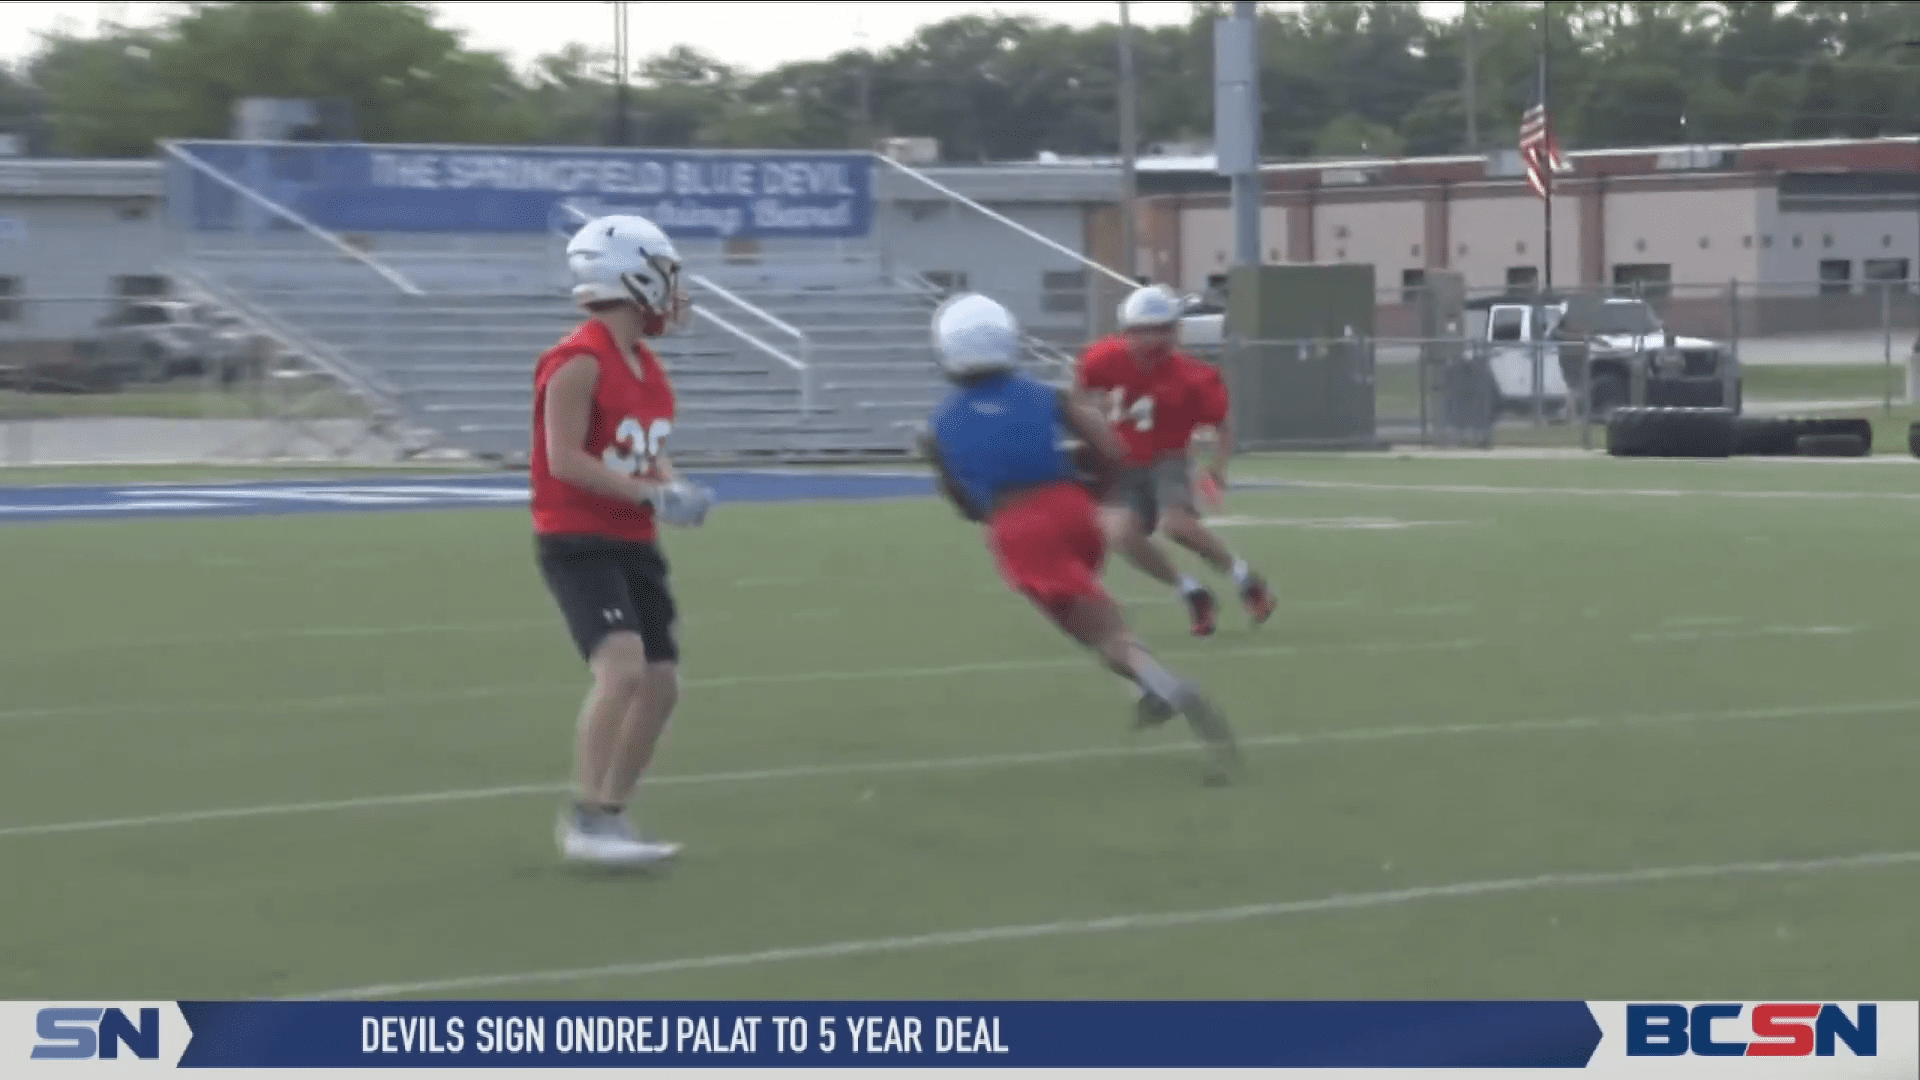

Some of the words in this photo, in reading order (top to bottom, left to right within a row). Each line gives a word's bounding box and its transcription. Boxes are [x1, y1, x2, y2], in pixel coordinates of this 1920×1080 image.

[370, 152, 440, 189] THE
[445, 154, 666, 195] SPRINGFIELD
[672, 159, 756, 196] BLUE
[760, 160, 855, 197] DEVIL
